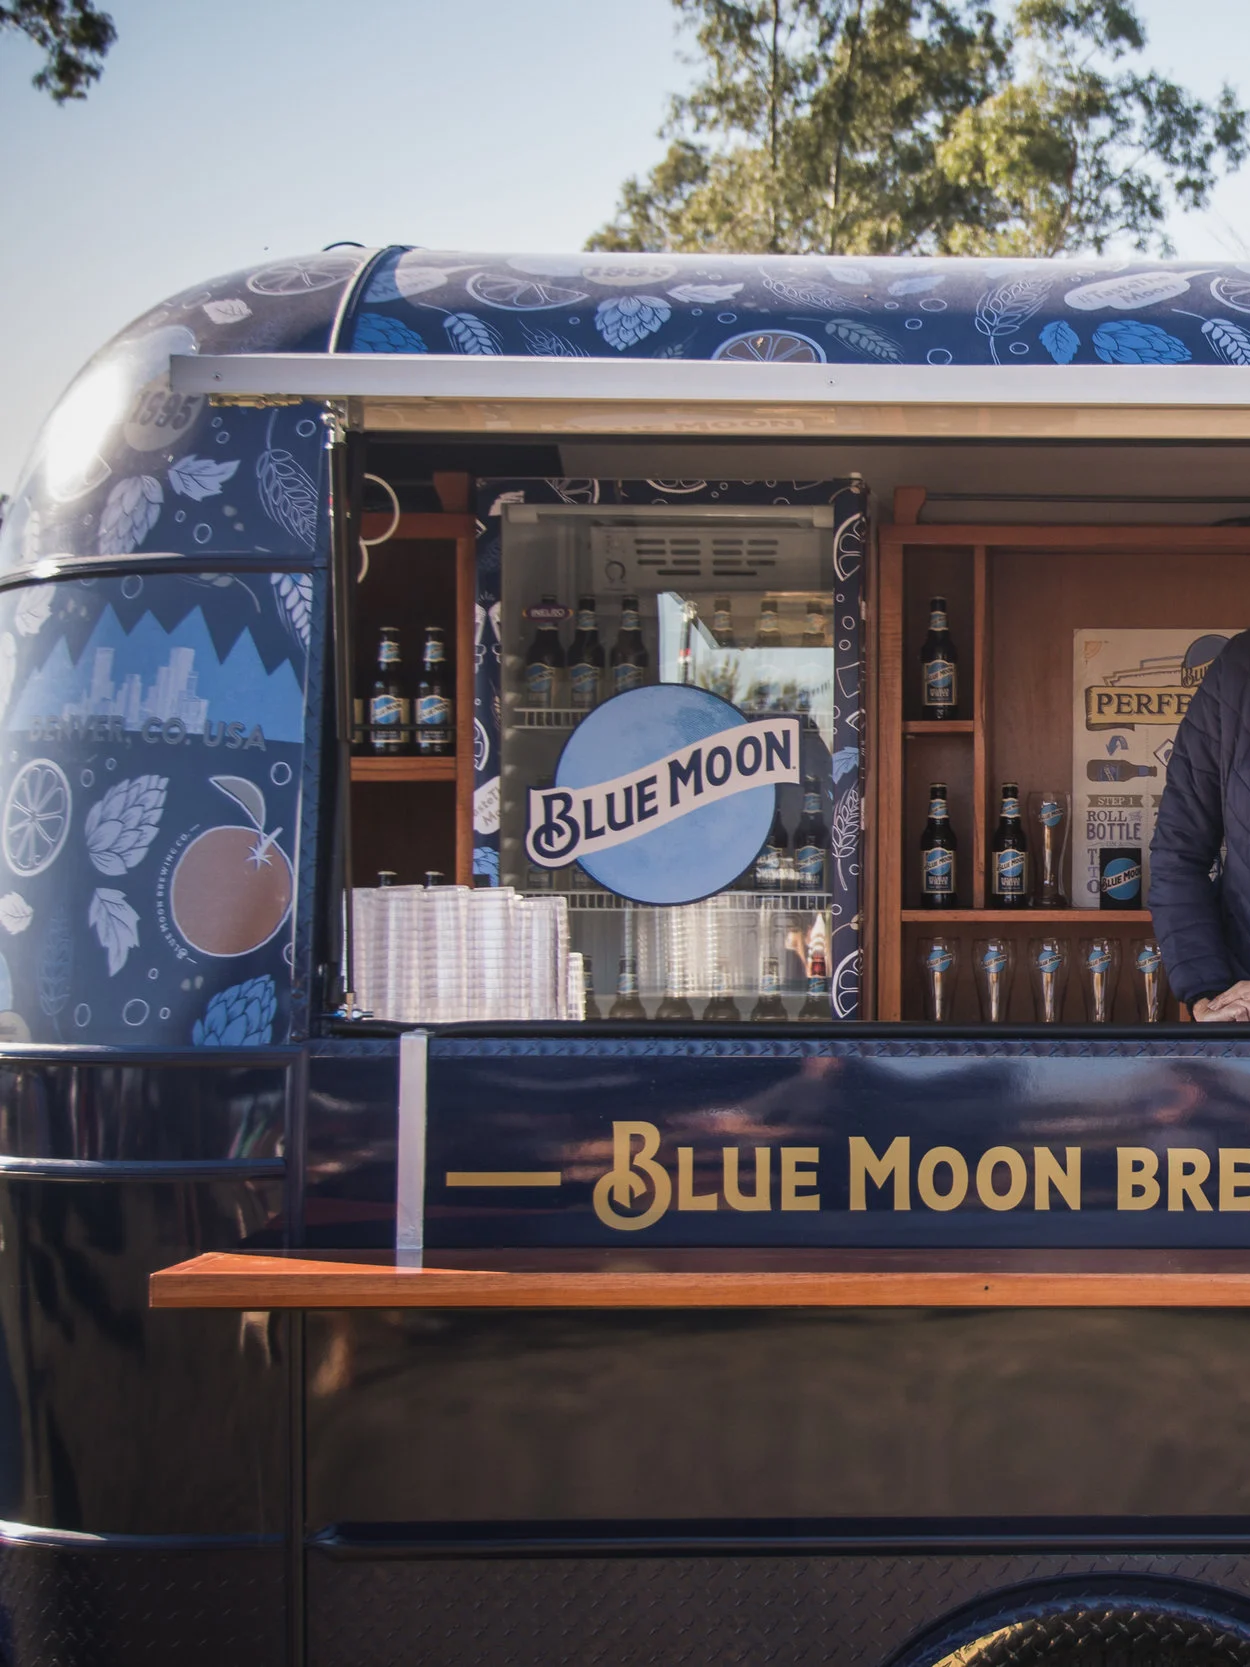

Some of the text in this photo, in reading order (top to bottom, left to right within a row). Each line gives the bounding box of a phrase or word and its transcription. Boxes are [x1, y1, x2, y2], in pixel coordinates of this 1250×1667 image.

[1183, 666, 1208, 687] BLU
[141, 716, 193, 746] CO.
[203, 719, 268, 752] USA
[532, 729, 792, 860] BLUE MOON
[1098, 796, 1133, 806] STEP 1
[1086, 810, 1127, 822] ROLL
[1086, 823, 1142, 840] BOTTLE
[156, 848, 178, 897] BREWING
[1100, 874, 1123, 891] BLUE
[592, 1119, 821, 1231] BLUE
[847, 1135, 1083, 1212] MOON
